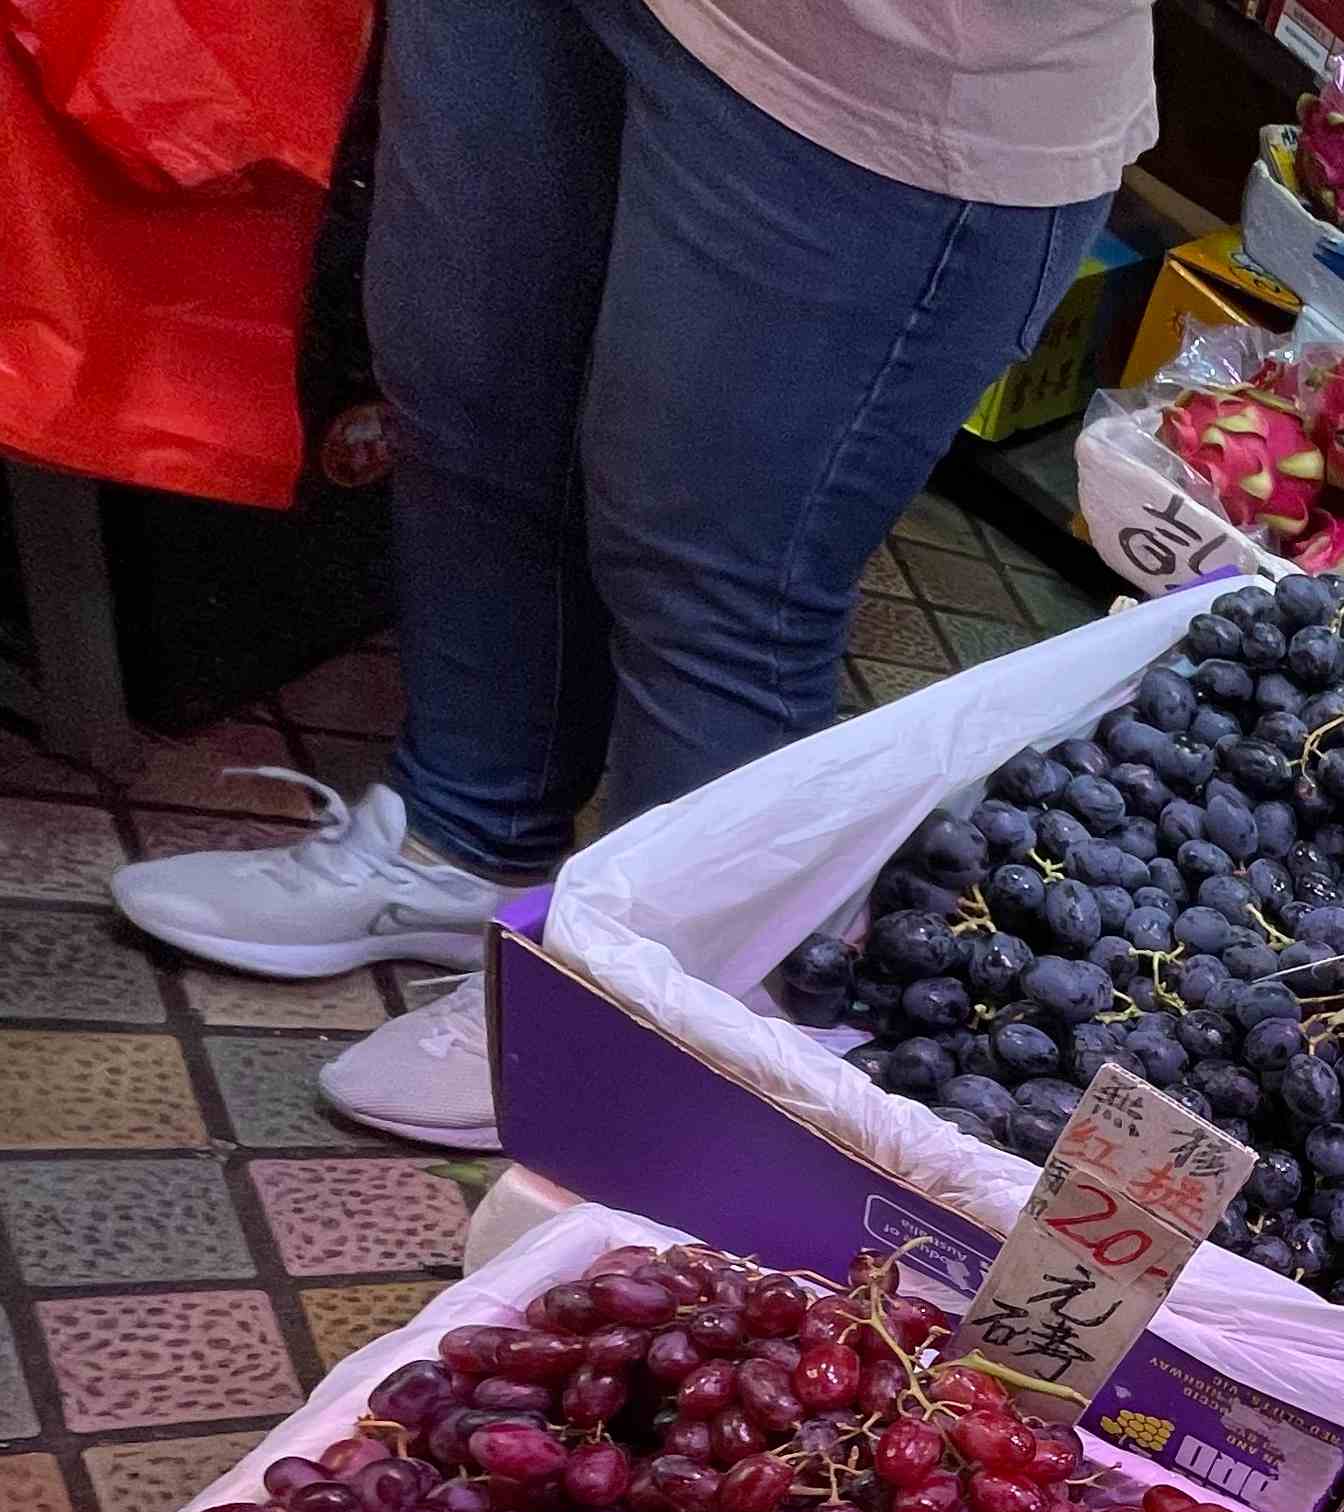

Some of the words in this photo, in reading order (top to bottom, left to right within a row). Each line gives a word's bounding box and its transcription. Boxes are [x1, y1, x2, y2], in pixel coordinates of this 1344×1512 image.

[1091, 1075, 1224, 1181] 無核
[1027, 1264, 1123, 1327] 元
[972, 1296, 1096, 1384] 磅
